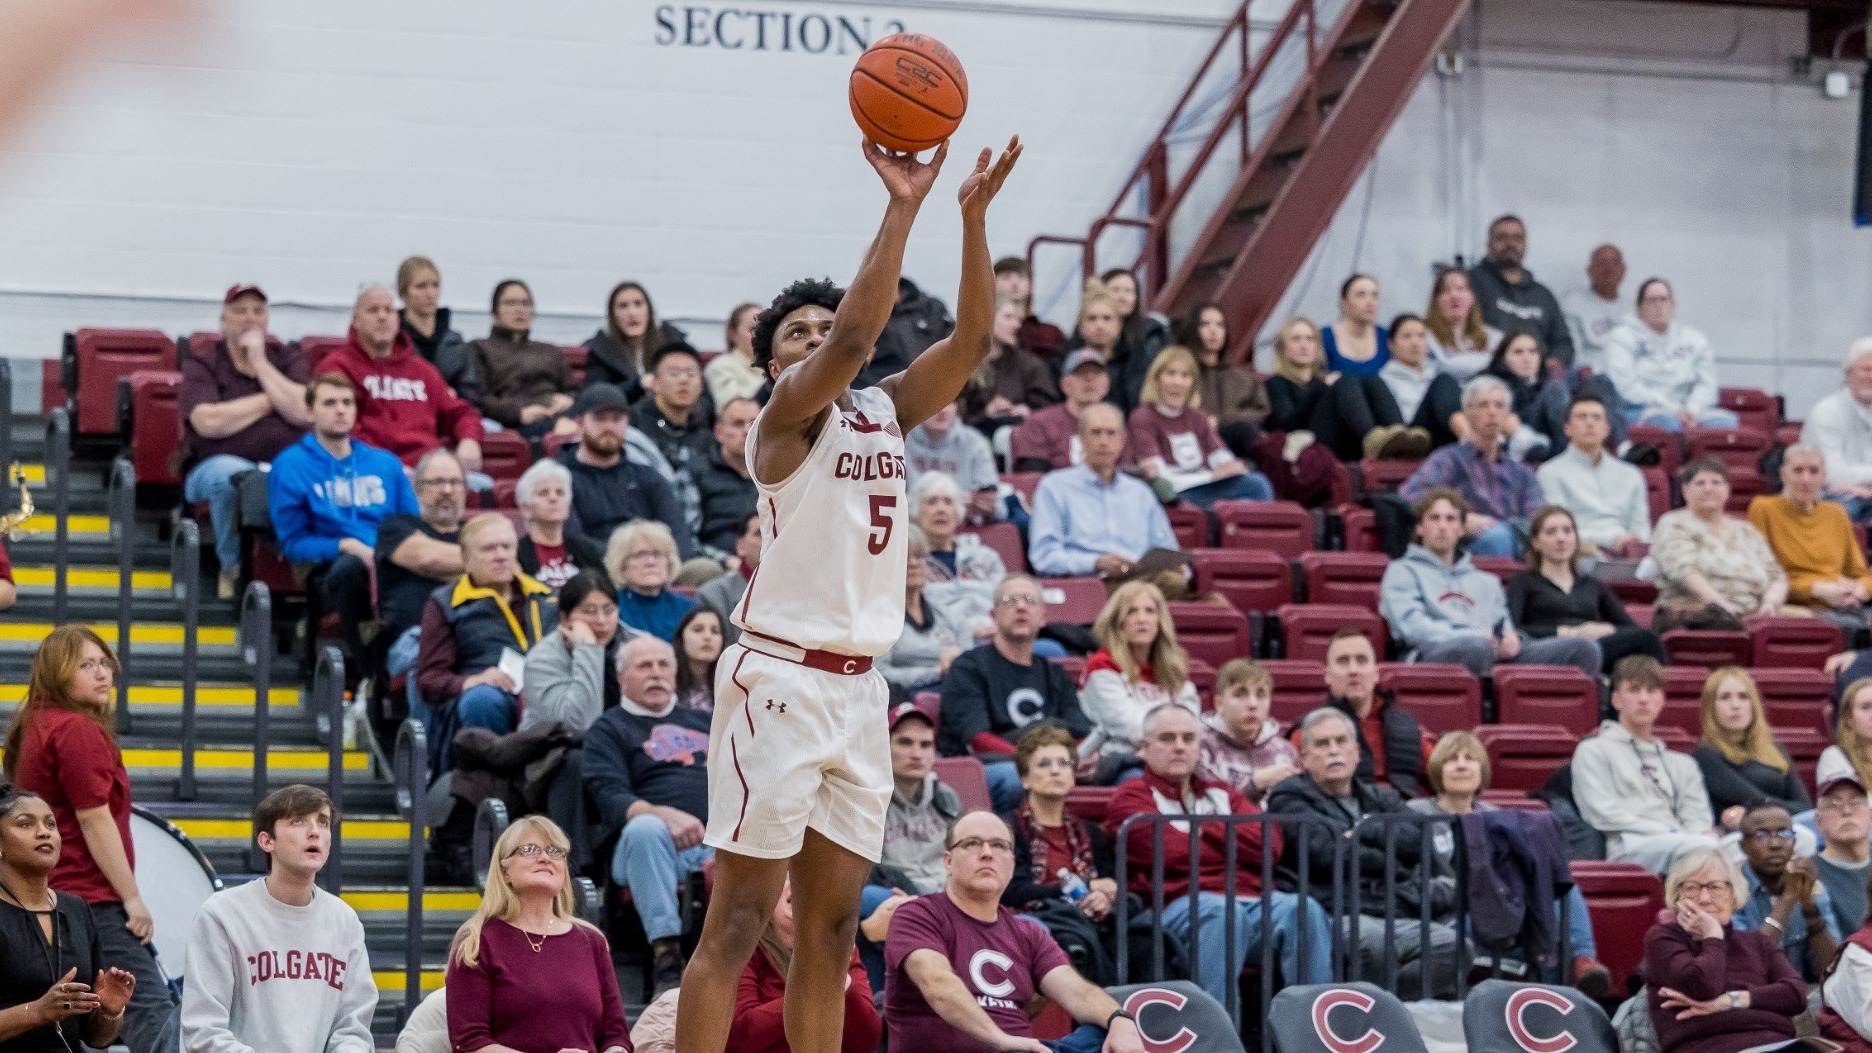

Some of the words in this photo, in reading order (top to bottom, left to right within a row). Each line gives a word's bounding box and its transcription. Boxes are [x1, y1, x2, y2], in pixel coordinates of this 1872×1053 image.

[654, 5, 871, 54] SECTION
[867, 494, 897, 556] 5
[843, 660, 857, 674] C
[1006, 687, 1045, 728] C
[247, 949, 347, 992] COLGATE
[968, 948, 1016, 998] C
[1122, 987, 1199, 1053] C
[1311, 988, 1386, 1053] C
[1505, 987, 1578, 1053] C
